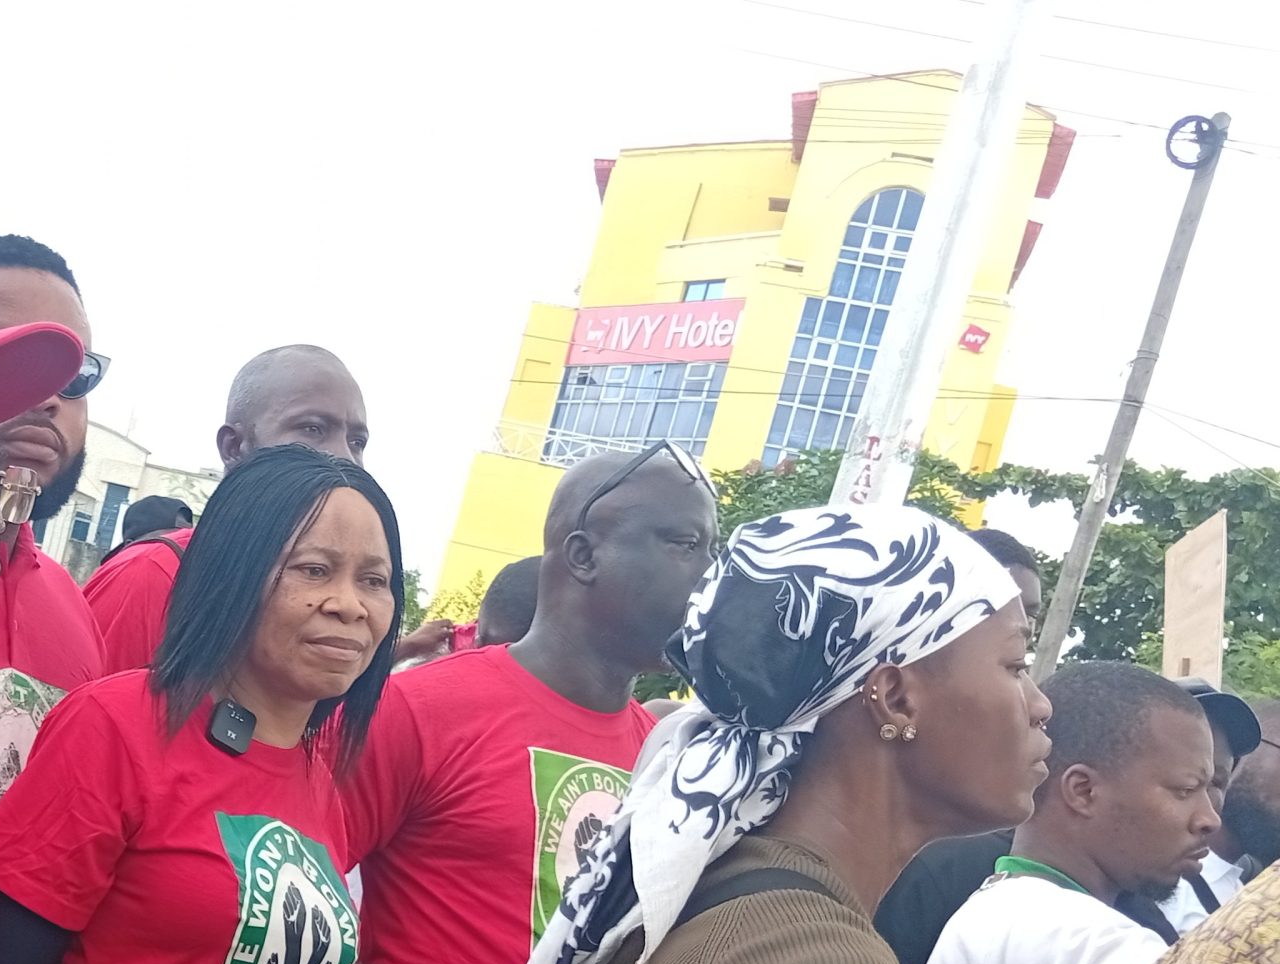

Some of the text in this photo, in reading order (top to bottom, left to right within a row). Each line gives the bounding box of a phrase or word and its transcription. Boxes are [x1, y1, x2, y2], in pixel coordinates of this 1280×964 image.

[610, 309, 744, 351] IVY Hotel
[544, 813, 564, 854] WE
[557, 773, 590, 816] AIN'T
[248, 833, 296, 930] WON'T
[301, 857, 357, 948] BOW
